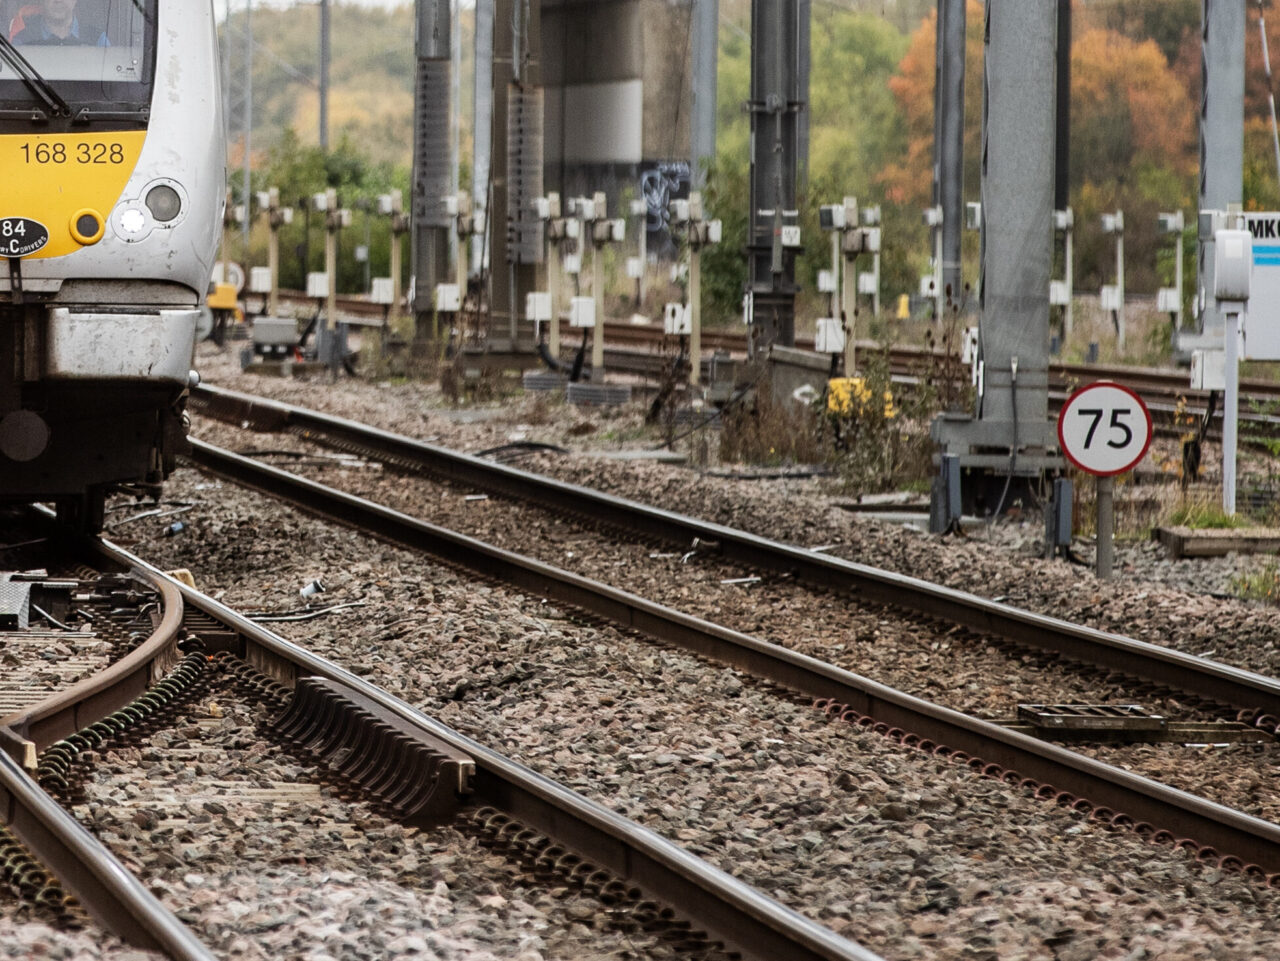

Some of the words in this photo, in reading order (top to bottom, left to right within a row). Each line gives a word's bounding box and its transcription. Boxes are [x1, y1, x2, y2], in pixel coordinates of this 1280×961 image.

[20, 142, 67, 164] 168
[76, 142, 125, 164] 328
[2, 220, 26, 237] 84
[1248, 219, 1280, 239] MK
[9, 239, 20, 254] C
[19, 235, 47, 254] DRIVERS
[1077, 408, 1133, 449] 75
